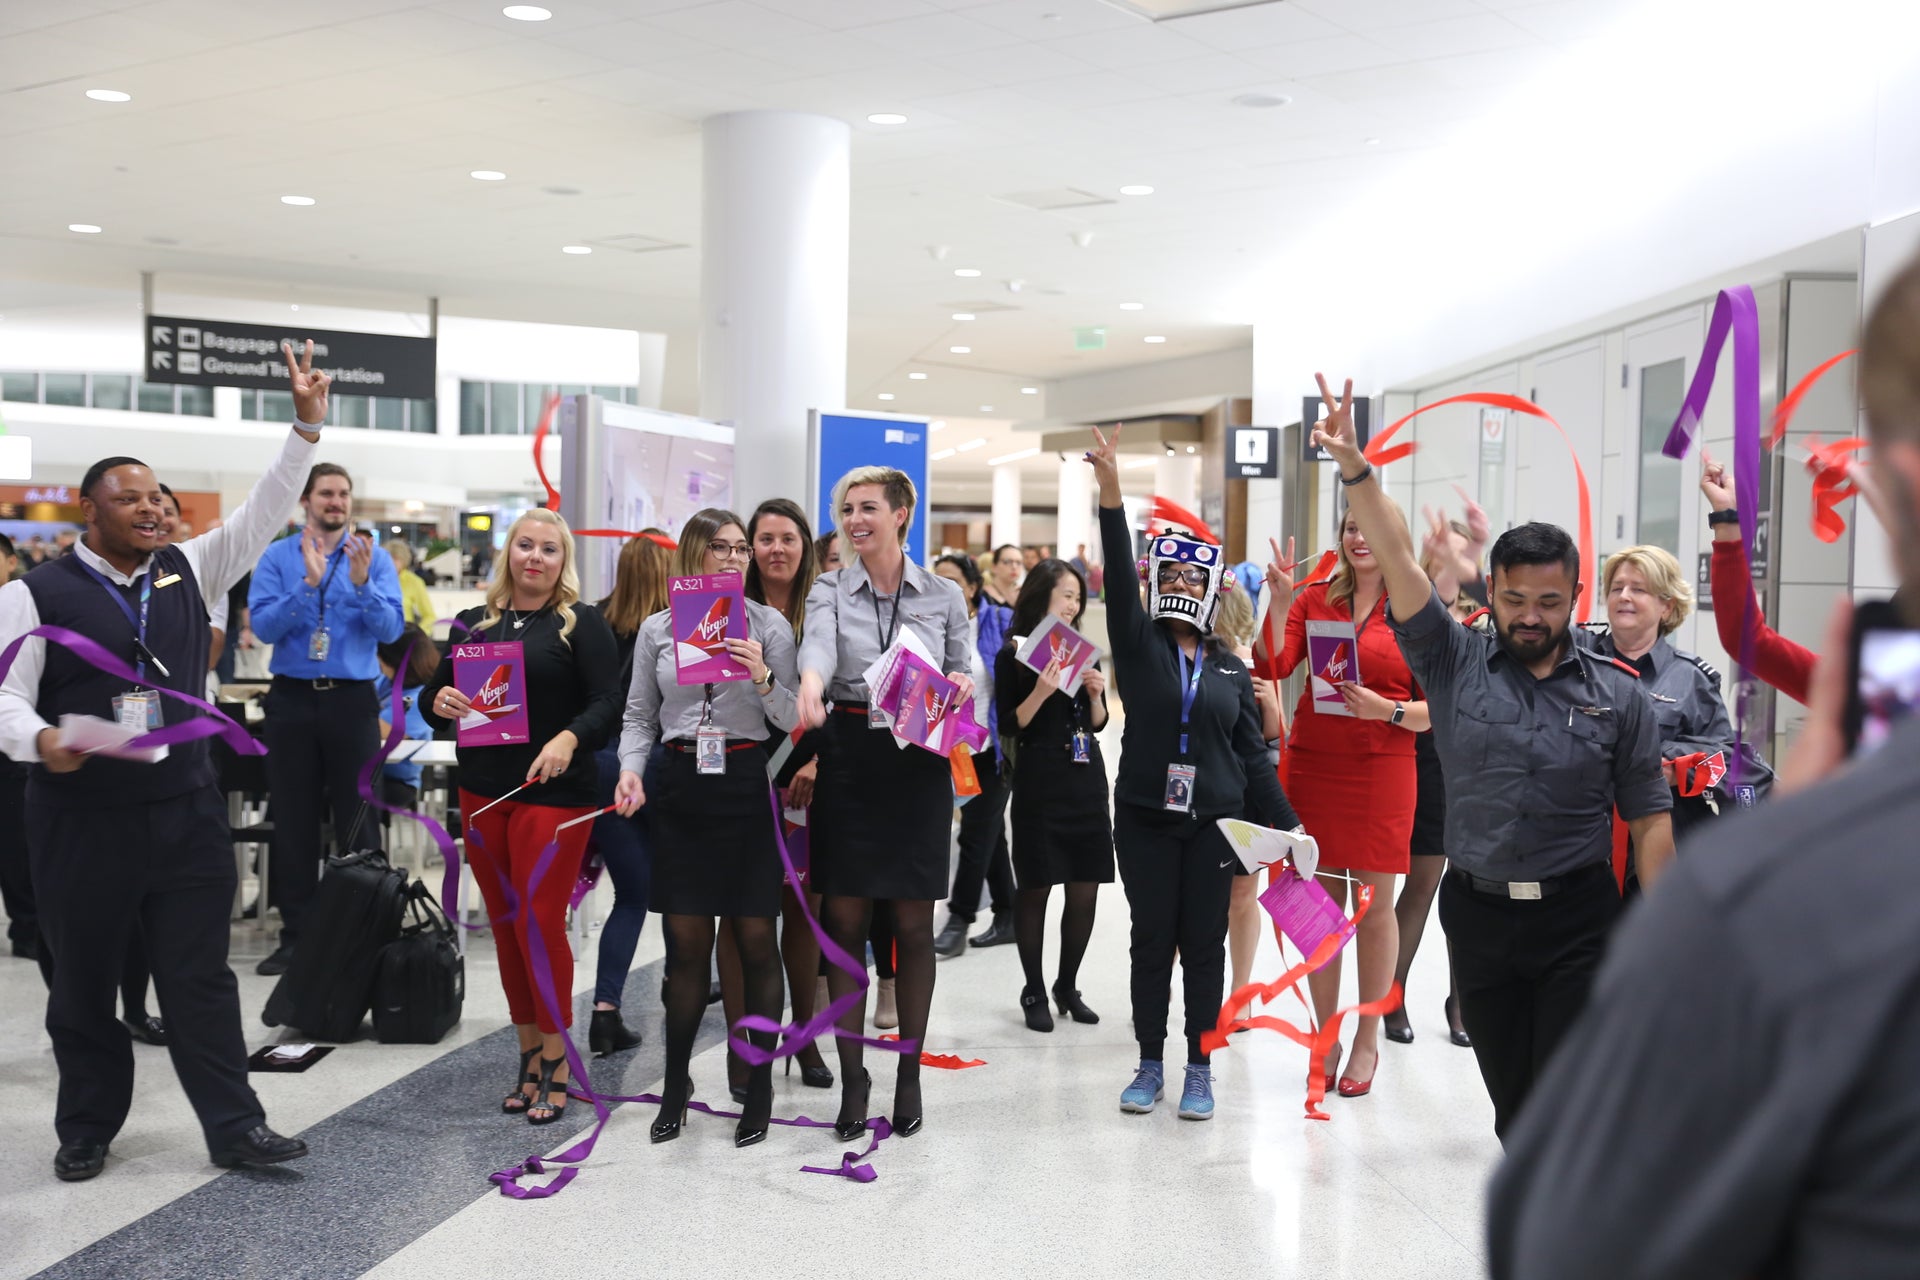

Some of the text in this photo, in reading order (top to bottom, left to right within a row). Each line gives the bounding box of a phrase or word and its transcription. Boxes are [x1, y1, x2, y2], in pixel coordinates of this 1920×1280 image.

[203, 331, 328, 357] Baggage Clam
[203, 356, 267, 377] Ground
[671, 578, 703, 591] A321
[698, 611, 729, 641] Virgin
[1309, 622, 1331, 634] A319
[456, 646, 485, 658] A321
[1327, 652, 1348, 680] Virgin
[479, 677, 509, 706] Virgin
[925, 692, 943, 724] Virgin
